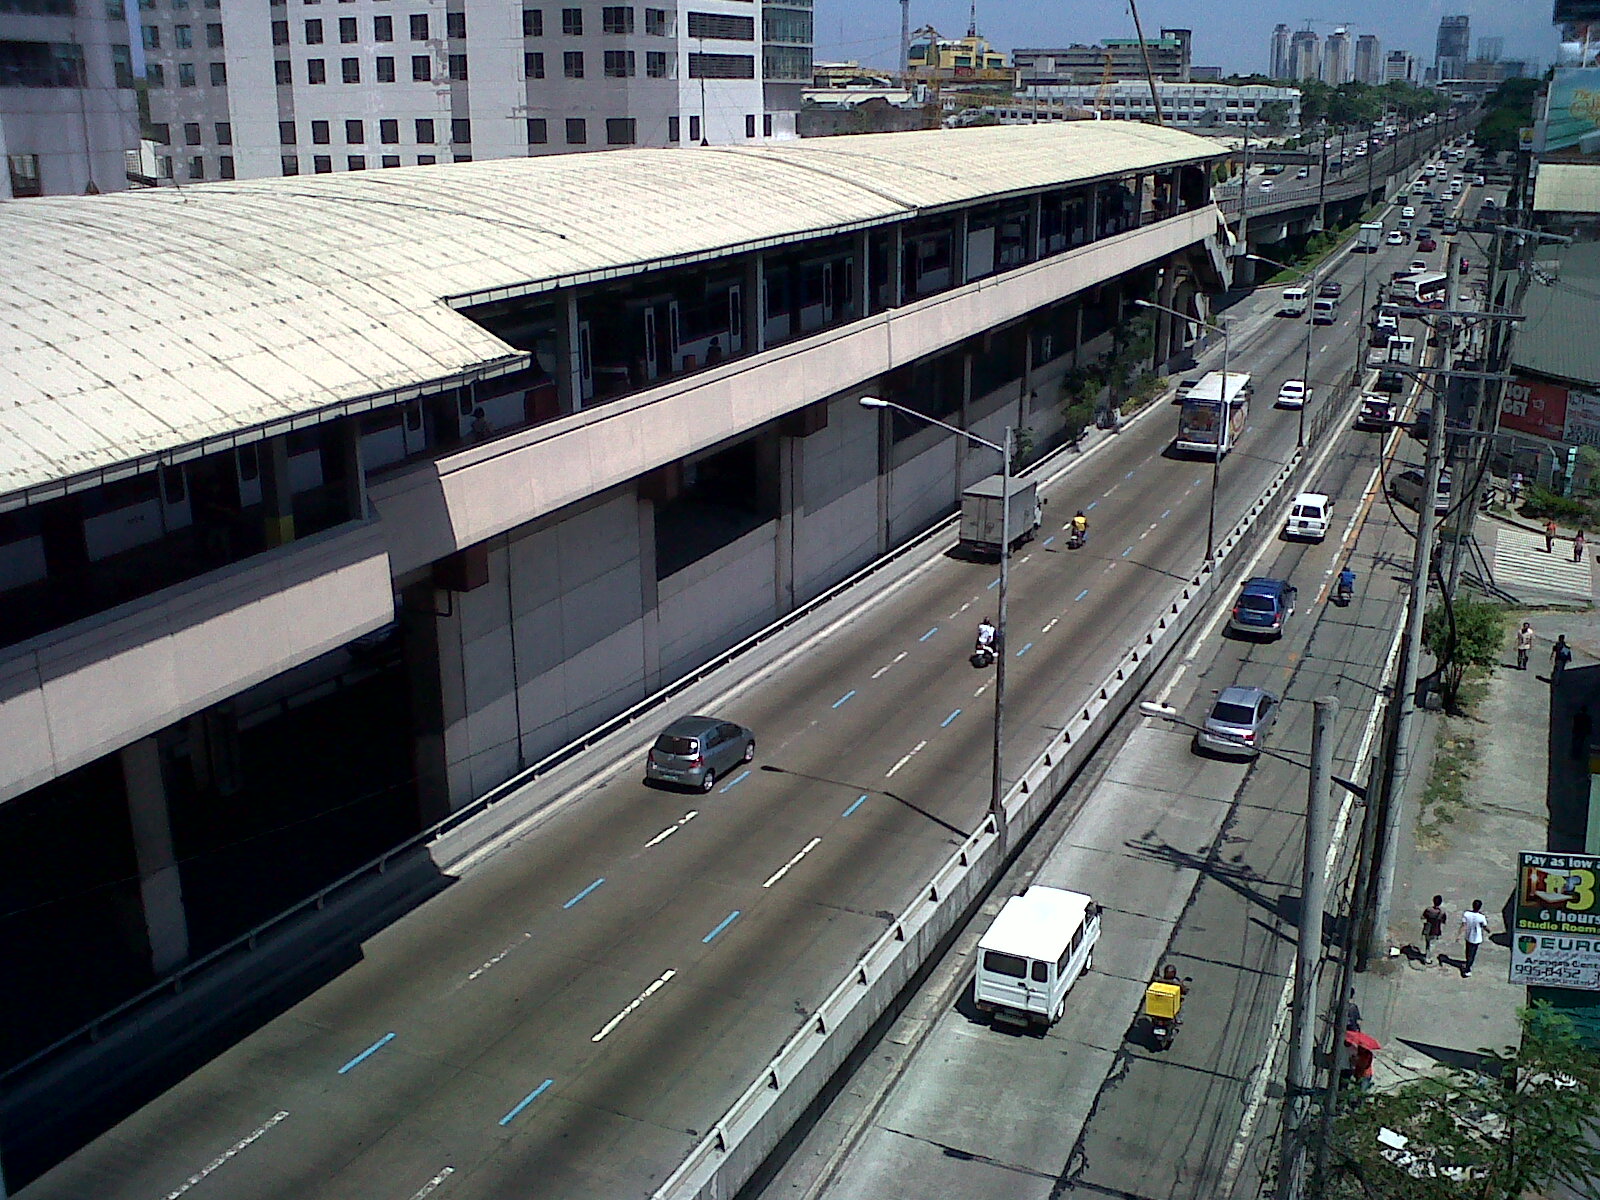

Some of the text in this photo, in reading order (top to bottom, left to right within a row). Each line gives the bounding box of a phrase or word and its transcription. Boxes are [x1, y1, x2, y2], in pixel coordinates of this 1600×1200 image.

[1524, 855, 1547, 867] Pay
[1550, 858, 1565, 867] as
[1568, 857, 1593, 869] low
[1540, 909, 1550, 920] 6
[1519, 919, 1559, 930] Studio
